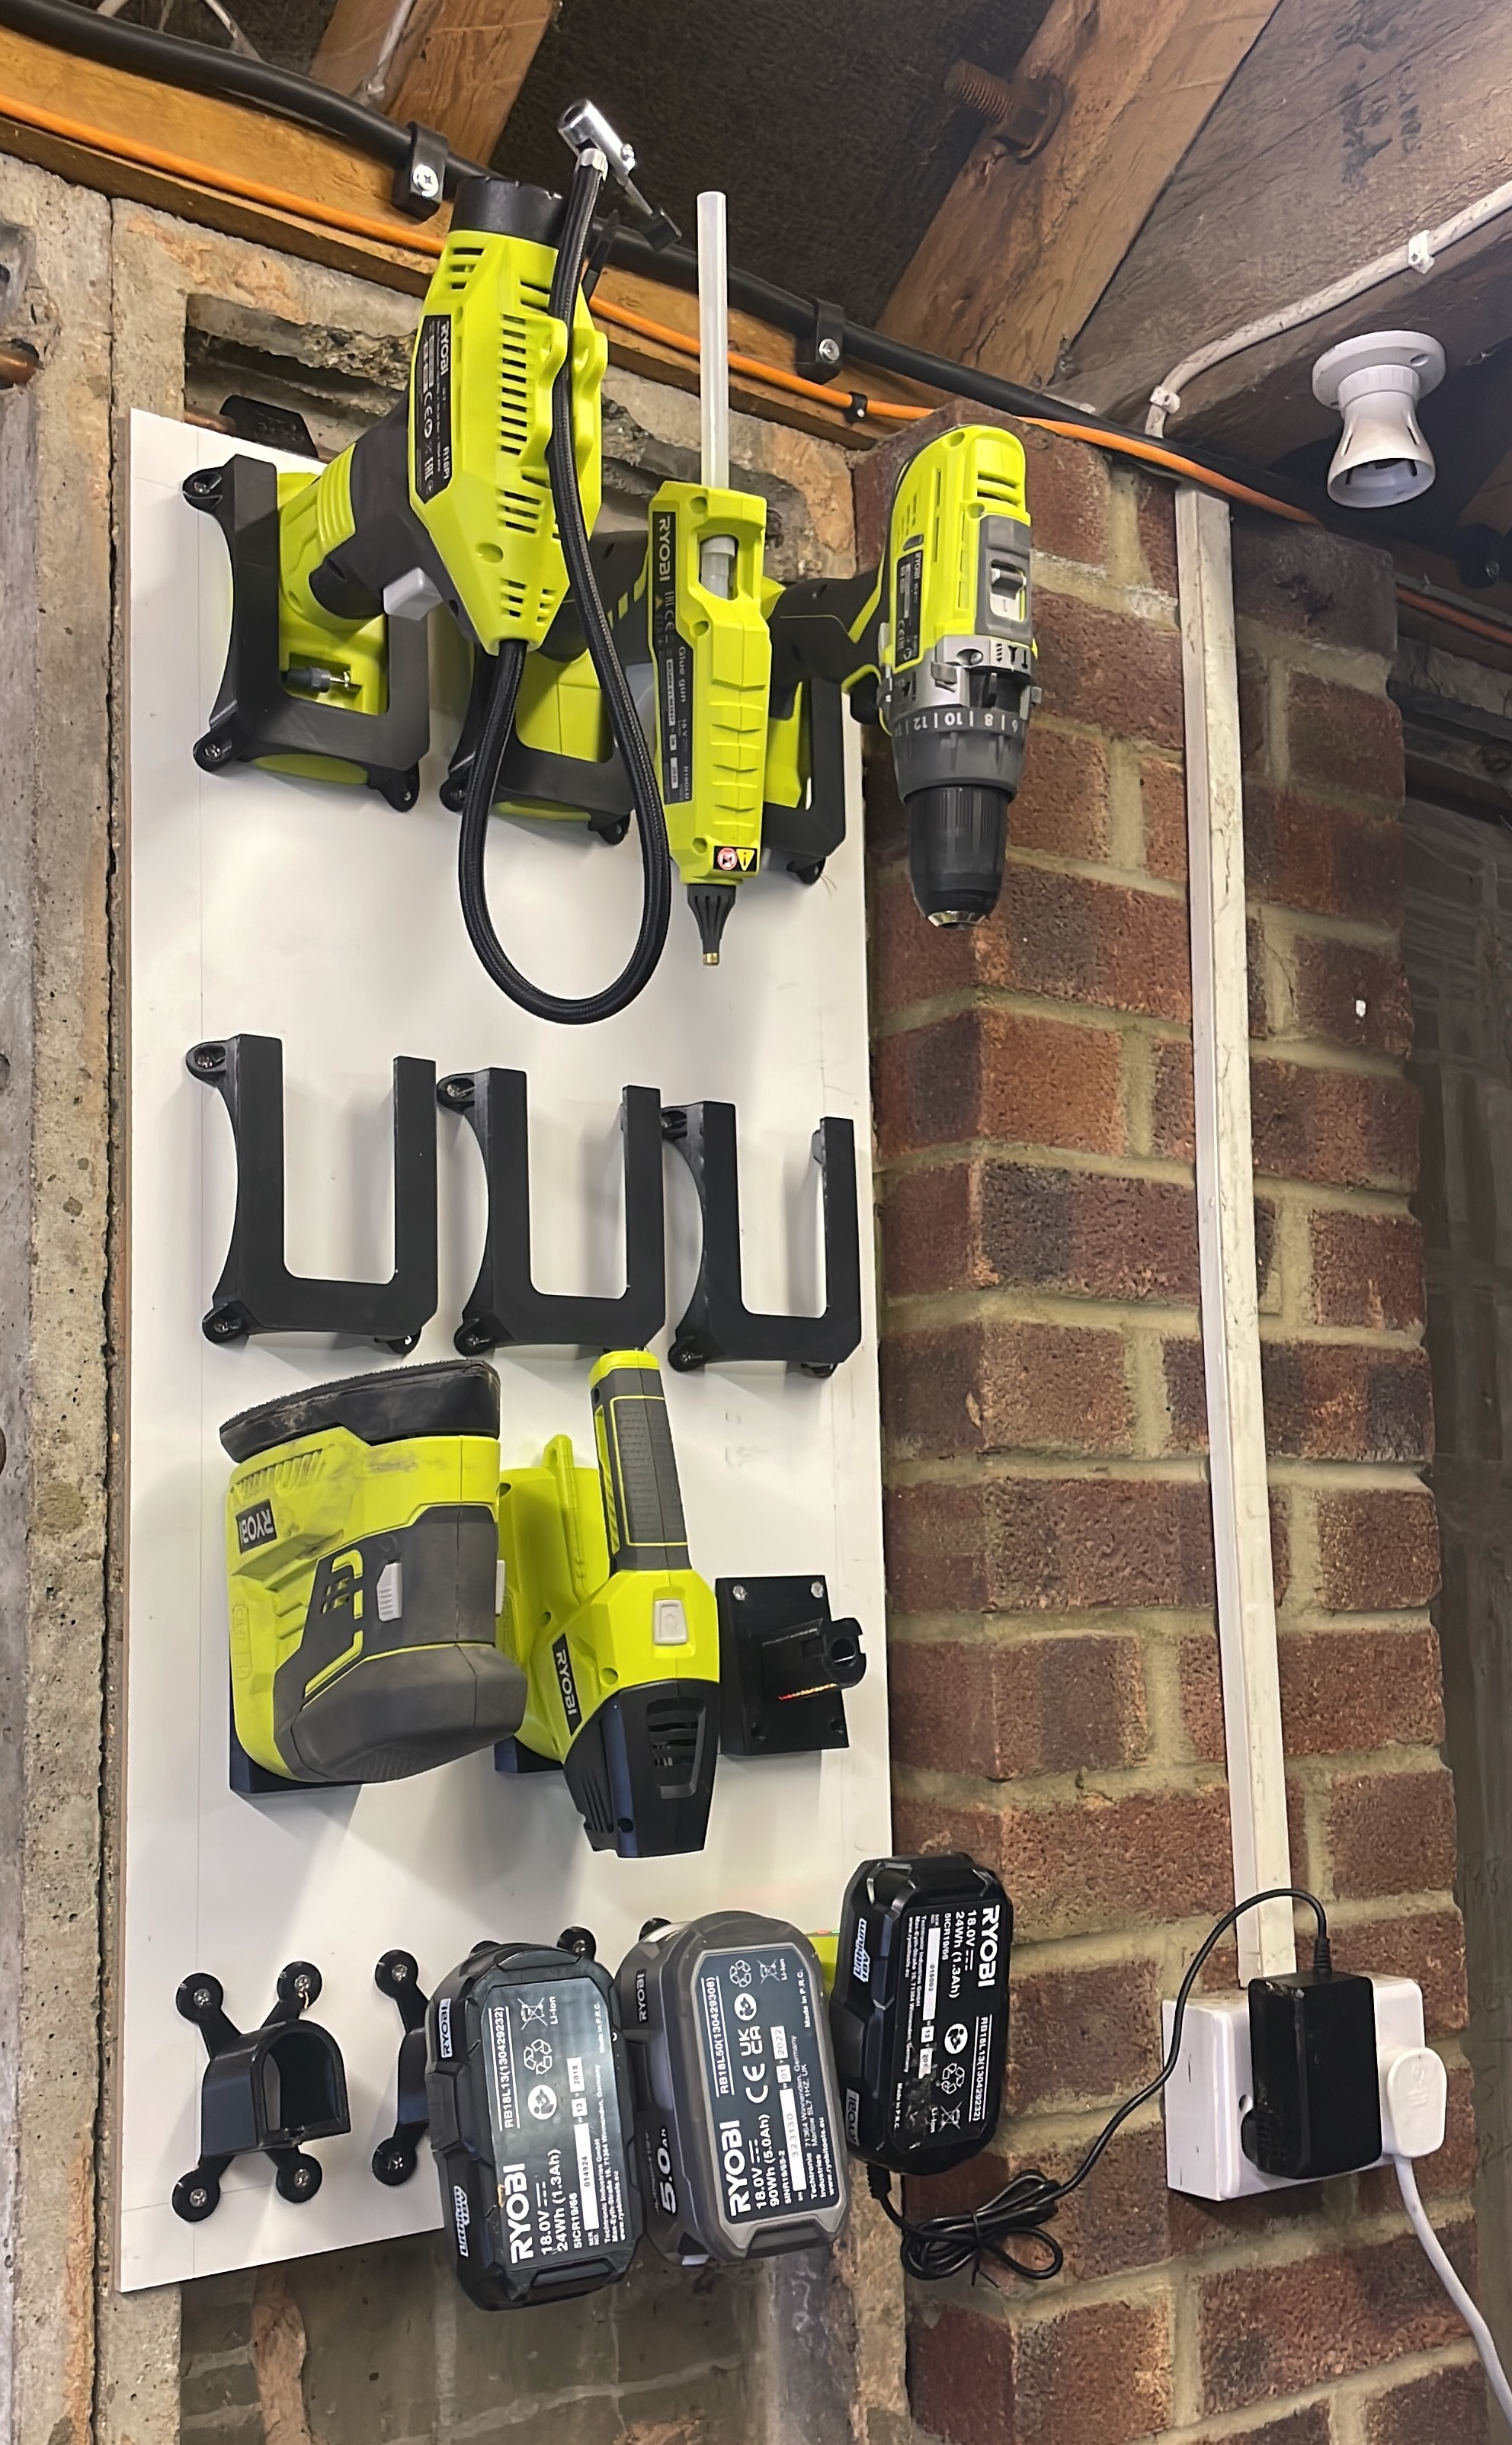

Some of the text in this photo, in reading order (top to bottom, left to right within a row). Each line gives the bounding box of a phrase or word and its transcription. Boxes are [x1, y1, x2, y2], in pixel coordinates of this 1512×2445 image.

[440, 321, 449, 375] RYOBI
[659, 516, 670, 582] RYOBI
[914, 716, 927, 730] 12
[944, 713, 963, 726] 10
[985, 713, 993, 726] 8
[239, 1509, 274, 1546] RYOBI
[556, 1649, 577, 1715] RYOBI
[966, 1910, 977, 1947] 18.0V
[979, 1905, 1000, 1987] RYOBI
[949, 1911, 964, 1998] 24Wh (1.3Ah)
[636, 1974, 647, 2022] RYOBI
[797, 1969, 806, 1994] P.R.C.
[800, 1995, 807, 2004] in
[441, 2006, 450, 2056] RYOBI
[706, 1976, 729, 2094] RB18L50(130429308)
[738, 2026, 763, 2056] UK CA
[774, 2029, 785, 2056] 2022
[494, 2007, 514, 2128] RB18L13(130429232)
[780, 2068, 788, 2079] 01
[790, 2035, 800, 2072] Germany
[801, 2064, 808, 2075] UK
[972, 2017, 988, 2121] RB18L13(130429232)
[594, 2064, 603, 2097] Germany
[742, 2063, 768, 2104] CE
[576, 2103, 583, 2113] 13
[848, 2097, 857, 2142] RYOBI
[786, 2113, 799, 2158] 323130
[809, 2117, 818, 2146] Marlow
[581, 2156, 591, 2187] 014924
[719, 2120, 751, 2216] RYOBI
[758, 2113, 780, 2206] 90Wh (5.0Ah)
[815, 2154, 826, 2198] Industries
[818, 2117, 834, 2196] www.ryobitools.eu
[547, 2149, 569, 2252] 24Wh (1.3Ah)
[597, 2164, 607, 2201] Industries
[751, 2168, 767, 2209] 18.0V
[503, 2163, 533, 2264] RYOBI
[537, 2210, 553, 2254] 18.0V
